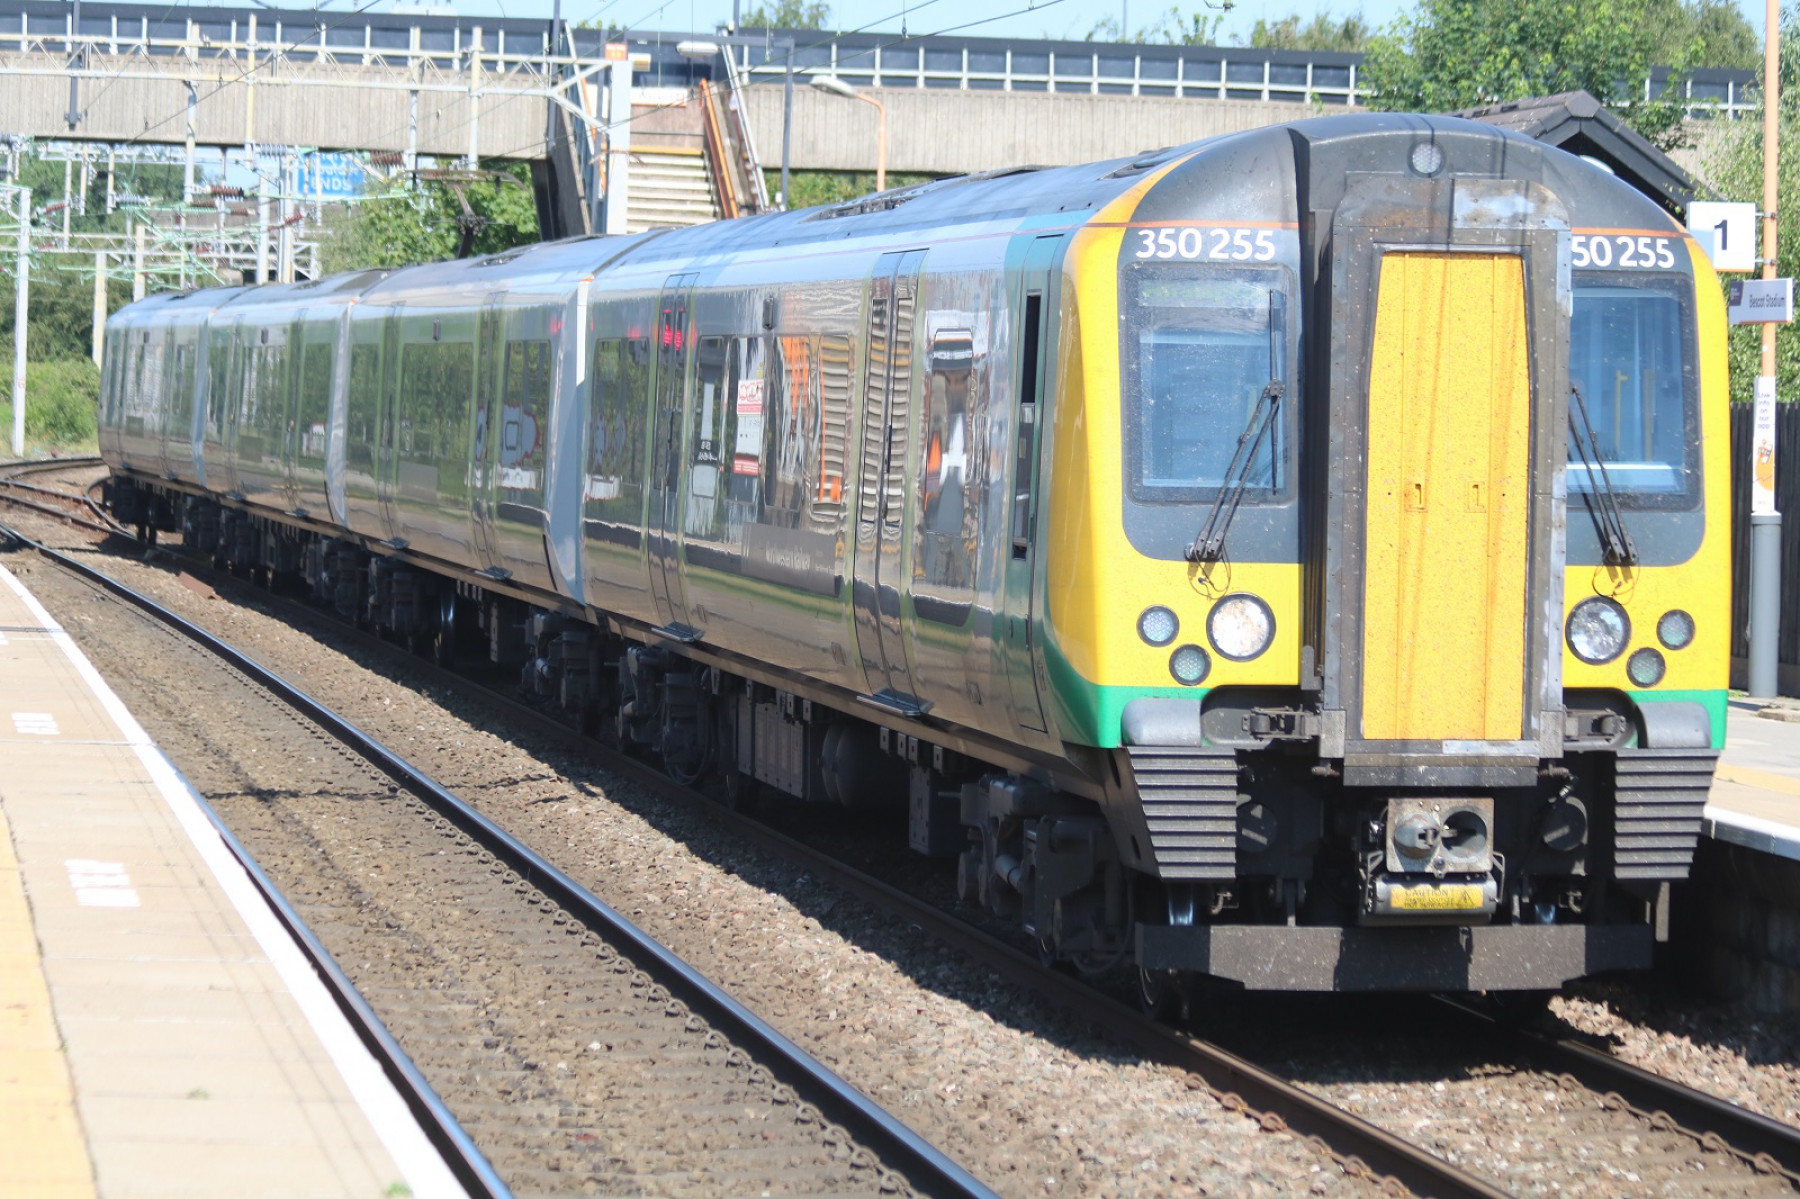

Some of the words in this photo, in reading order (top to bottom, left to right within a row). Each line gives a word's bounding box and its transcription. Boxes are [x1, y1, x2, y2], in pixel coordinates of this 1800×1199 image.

[1136, 228, 1202, 259] 350
[1209, 229, 1275, 261] 255
[1714, 219, 1728, 251] 1
[1571, 236, 1612, 267] 50
[1615, 236, 1675, 269] 255
